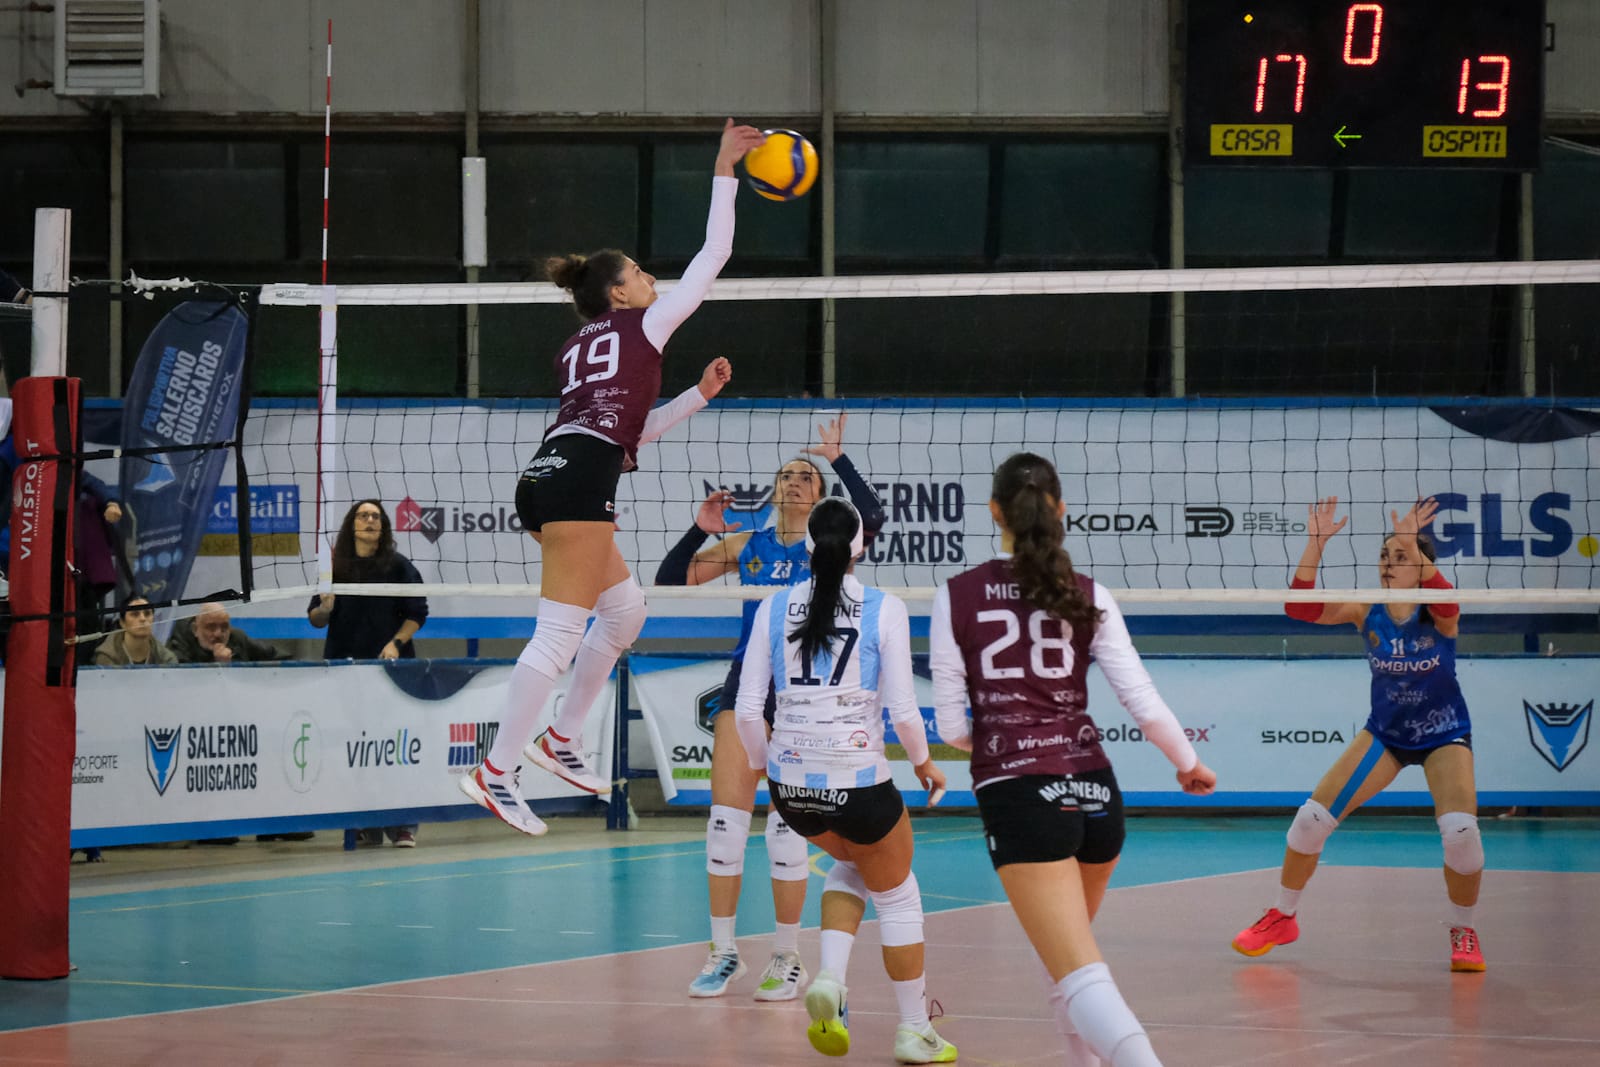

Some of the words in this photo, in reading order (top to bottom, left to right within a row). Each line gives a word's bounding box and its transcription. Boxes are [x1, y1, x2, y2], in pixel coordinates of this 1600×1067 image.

[1343, 4, 1383, 65] 0
[1254, 54, 1307, 113] 17
[1457, 55, 1510, 117] 13
[1222, 130, 1281, 150] CASA
[1429, 130, 1502, 153] OSPITI
[579, 319, 612, 337] ERRA
[561, 331, 620, 395] 19
[156, 350, 197, 438] SALERNO
[173, 340, 222, 445] GUISCARDS
[20, 439, 40, 560] VIVISPOT
[831, 482, 963, 523] ERNO
[1066, 514, 1159, 532] KODA
[1243, 512, 1289, 522] DEL
[1243, 522, 1306, 533] PRIO
[856, 530, 964, 563] CARDS
[788, 602, 861, 618] CAONE
[787, 627, 859, 686] 17
[977, 609, 1075, 680] 28
[1390, 638, 1405, 655] 11
[187, 725, 258, 759] SALERNO
[346, 729, 421, 767] virvelle
[186, 763, 257, 793] GUISCARDS
[778, 784, 849, 806] MUGAVERO
